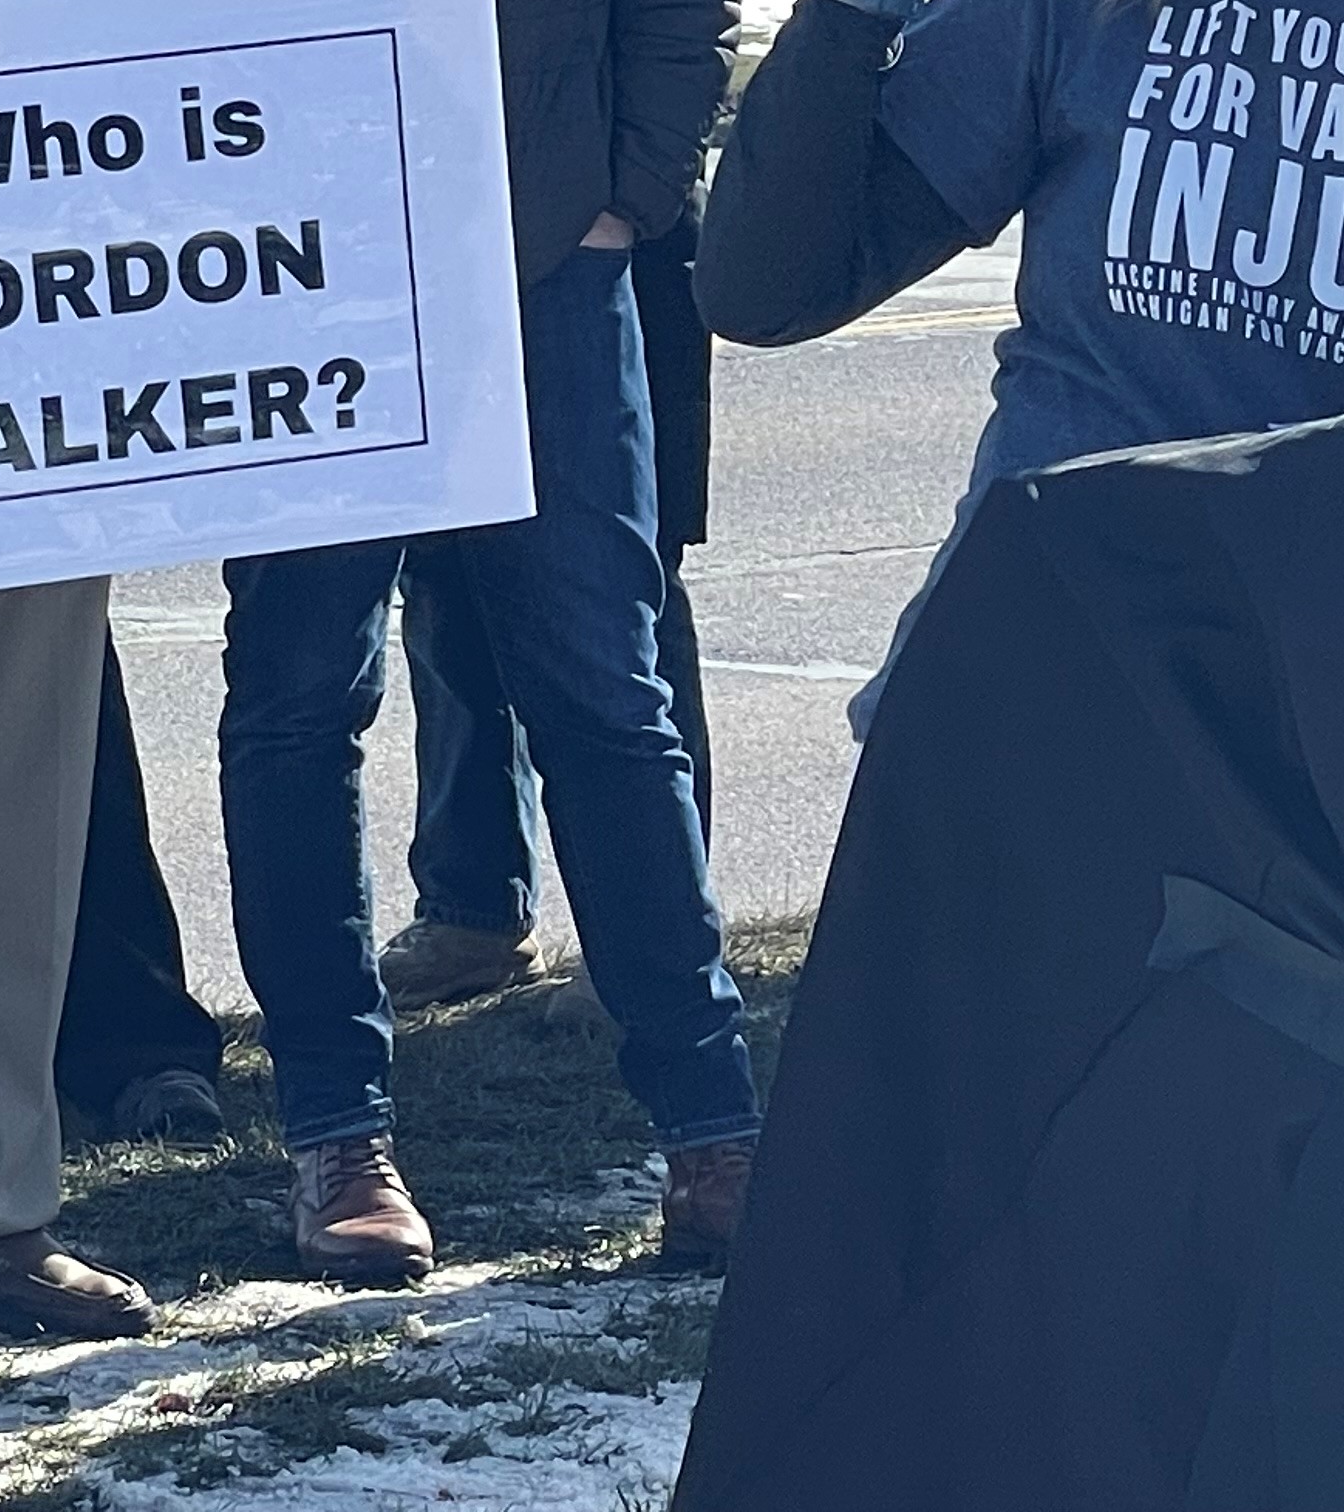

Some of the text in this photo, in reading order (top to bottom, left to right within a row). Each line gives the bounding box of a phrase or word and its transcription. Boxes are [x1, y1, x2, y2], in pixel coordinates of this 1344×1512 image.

[1148, 0, 1257, 57] LIFT
[180, 86, 265, 162] is
[1127, 62, 1256, 138] FOR
[1104, 261, 1198, 297] VACCINE
[1211, 277, 1296, 323] INJURY
[1108, 288, 1229, 332] MICHIGAN
[1244, 313, 1285, 348] FOR
